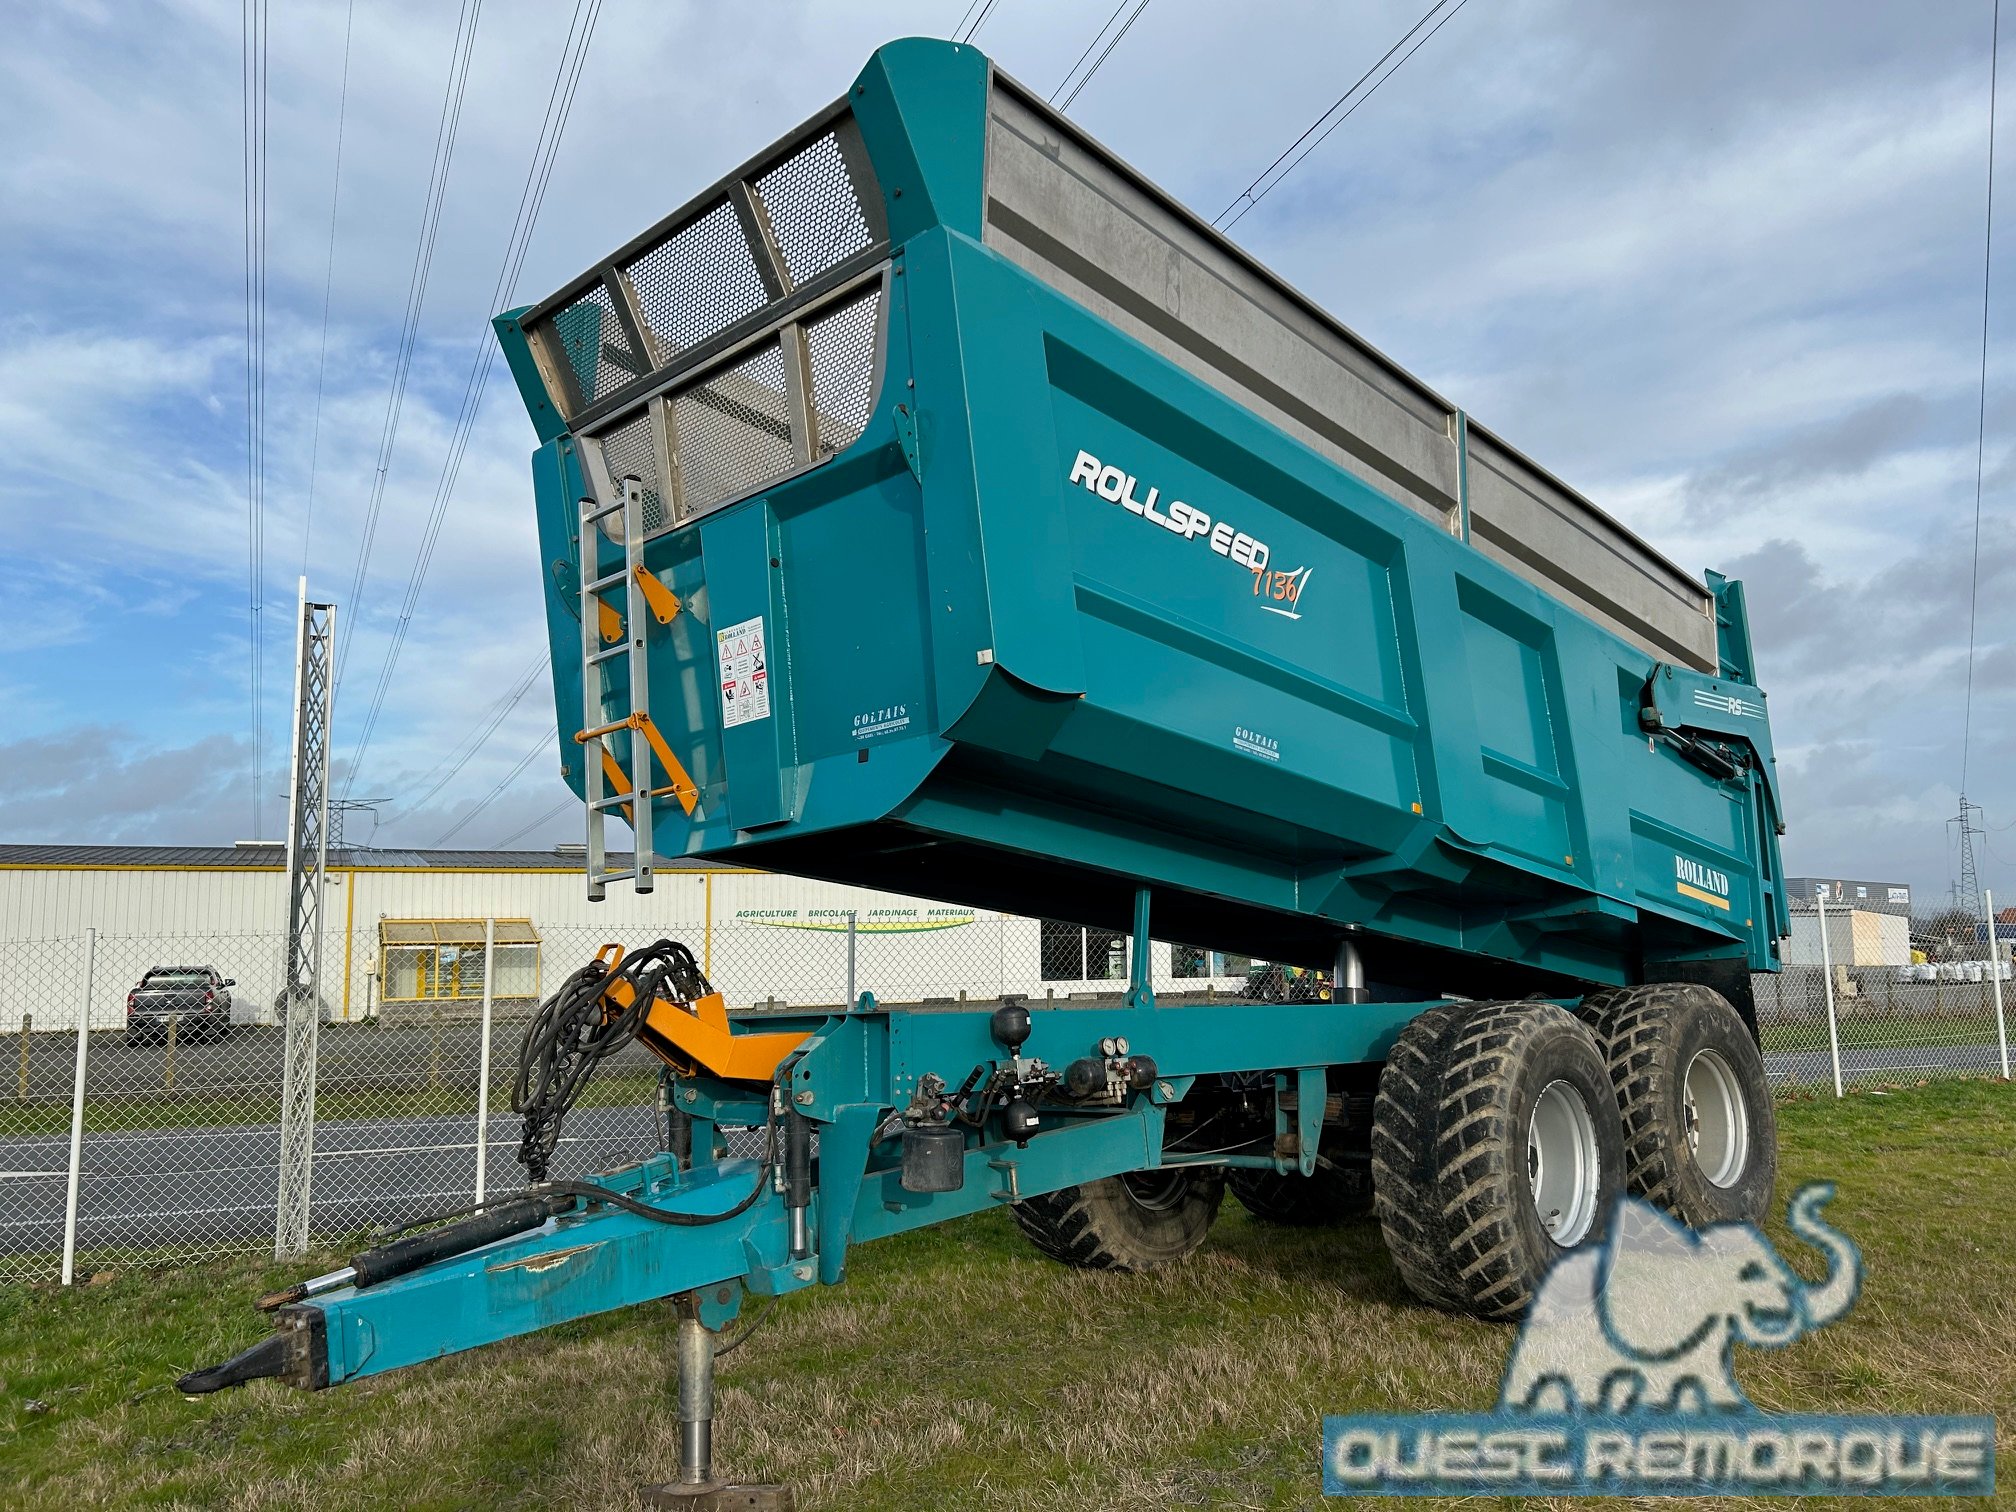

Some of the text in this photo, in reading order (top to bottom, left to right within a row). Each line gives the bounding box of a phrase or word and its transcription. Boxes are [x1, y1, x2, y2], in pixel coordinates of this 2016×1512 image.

[1069, 449, 1271, 571] ROLLSPEED
[1252, 566, 1298, 602] 7136
[853, 703, 907, 727] GOLTAIS
[1728, 696, 1742, 716] RS
[1235, 726, 1279, 750] GOLTAIS
[1675, 854, 1729, 896] ROLLAND
[736, 908, 975, 918] AGRICULTURE BRICOLAGE JARDINAGE MATERIAUX
